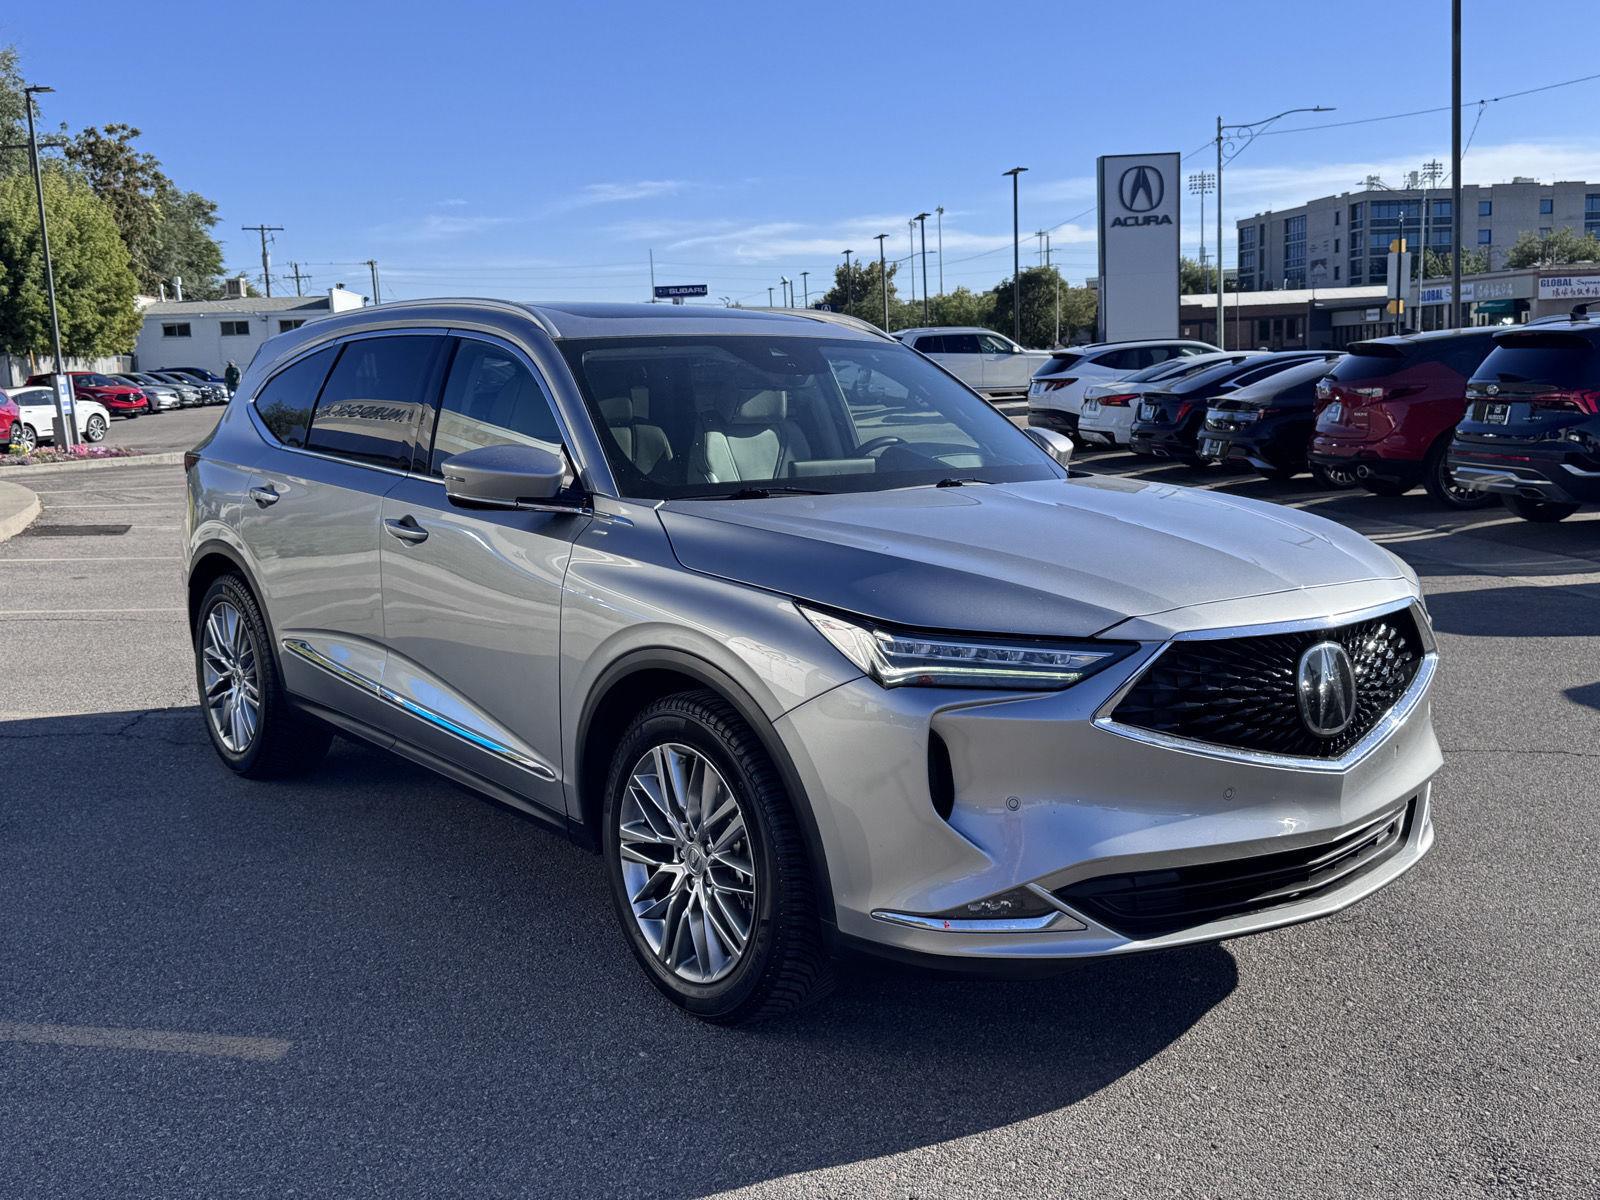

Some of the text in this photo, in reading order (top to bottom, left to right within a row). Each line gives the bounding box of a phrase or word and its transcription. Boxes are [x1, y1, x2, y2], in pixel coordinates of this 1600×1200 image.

[1110, 214, 1173, 228] ACURA
[1541, 278, 1573, 288] GLOBAL
[669, 287, 707, 295] SUBARU
